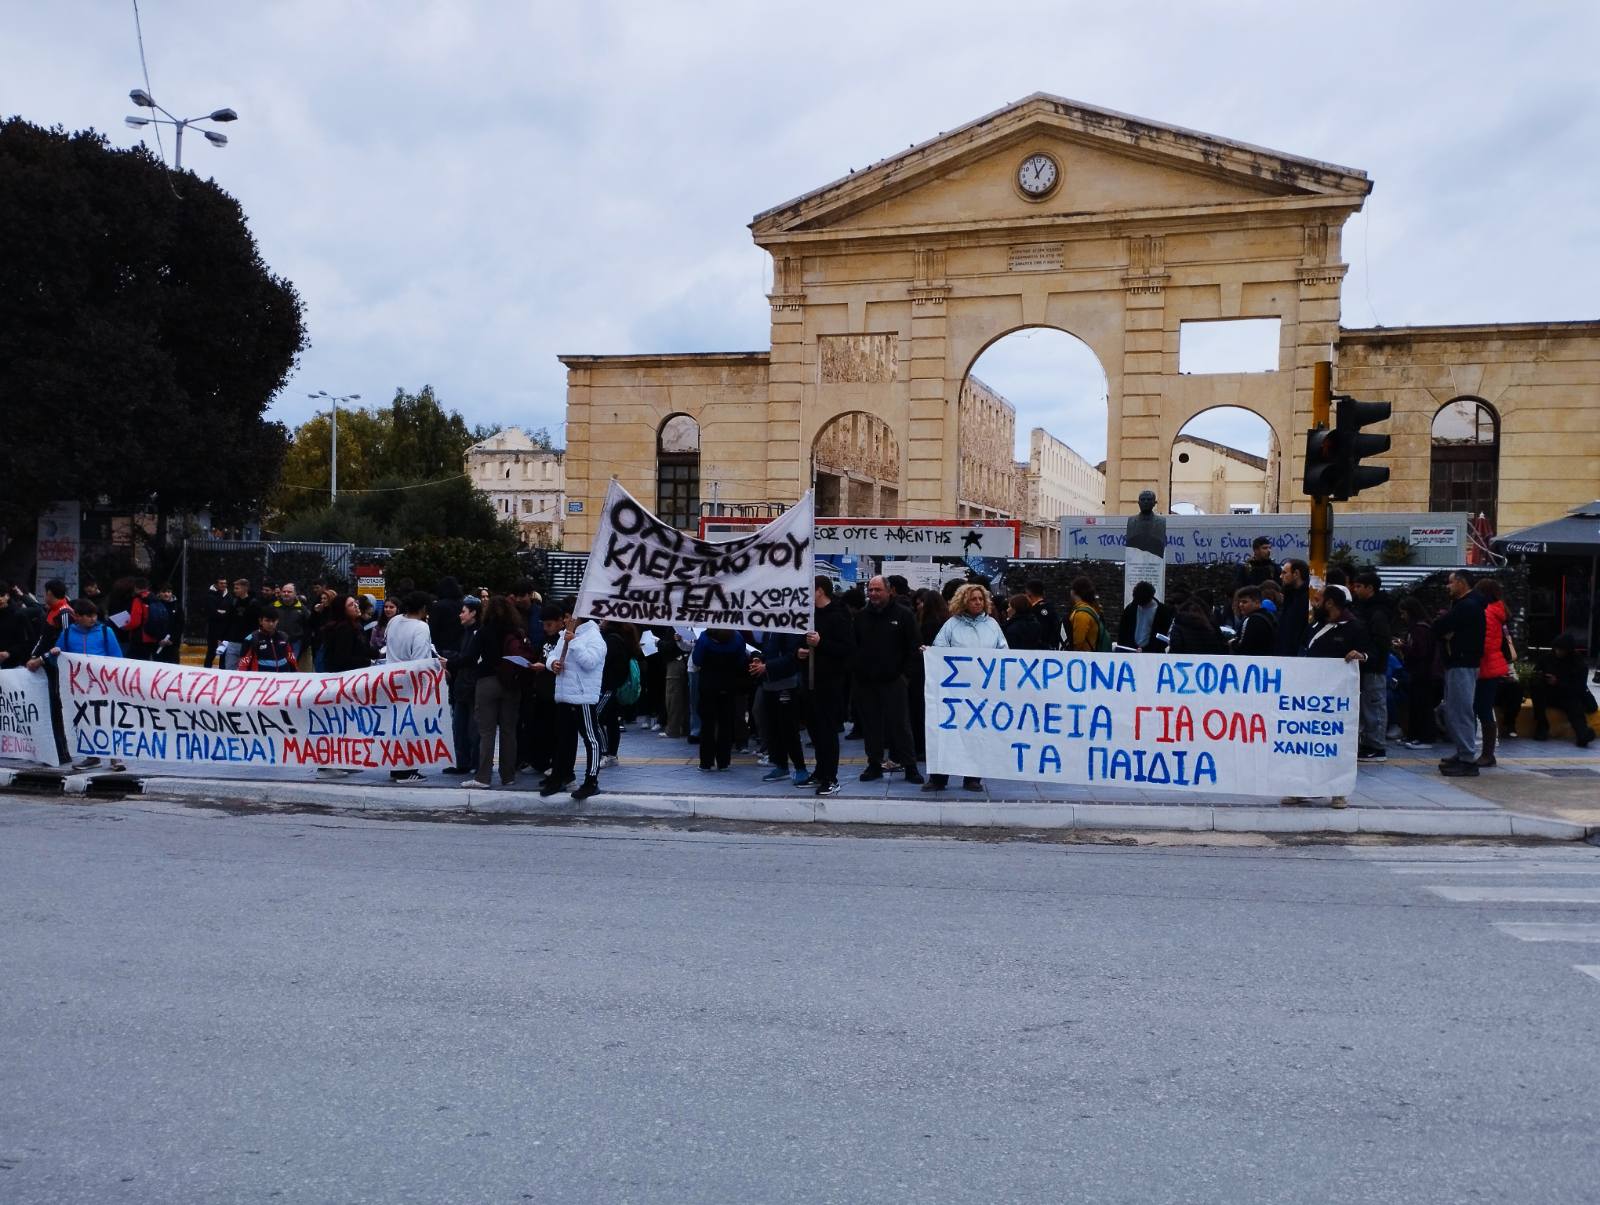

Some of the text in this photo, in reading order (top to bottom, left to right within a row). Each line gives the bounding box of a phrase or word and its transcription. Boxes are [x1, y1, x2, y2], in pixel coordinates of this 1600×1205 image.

[610, 499, 683, 552] ΟΧΙ
[814, 525, 953, 544] ΕΟΣ ΟΥΤΕ ΑΦΕΝΤΗΣ
[603, 531, 810, 579] ΚΛΕΙΣΙΜΟ ΤΟΥ
[589, 599, 673, 622] ΣΧΟΛΙΚΗ
[747, 609, 811, 631] ΟΛΟΥΣ
[67, 659, 446, 708] ΚΑΜΙΑ ΚΑΤΑΡΓΗΣΗ ΣΧΟΛΕΙΟΥ
[940, 656, 1282, 695] ΣΥΓΧΡΟΝΑ ΑΣΦΑΛΗ
[73, 700, 167, 731] ΧΤΙΣΤΕ
[166, 708, 298, 736] ΣΧΟΛΕΙΑ!
[308, 705, 420, 738] ΔΗΜΟΣΙΑ
[939, 698, 1267, 743] ΣΧΟΛΕΙΑ ΓΙΑ ΟΛΑ
[1278, 696, 1350, 713] ΕΝΩΣΗ
[1277, 720, 1344, 736] ΓΟΝΕΩΝ
[76, 728, 454, 768] ΔΩΡΕΑΝ ΠΑΙΔΕΙΑ! ΜΑΘΗΤΕΣ ΧΑΝΙΑ
[1011, 743, 1217, 785] ΤΑ ΠΑΙΔΙΑ
[1273, 741, 1338, 757] ΧΑΝΙΩΝ
